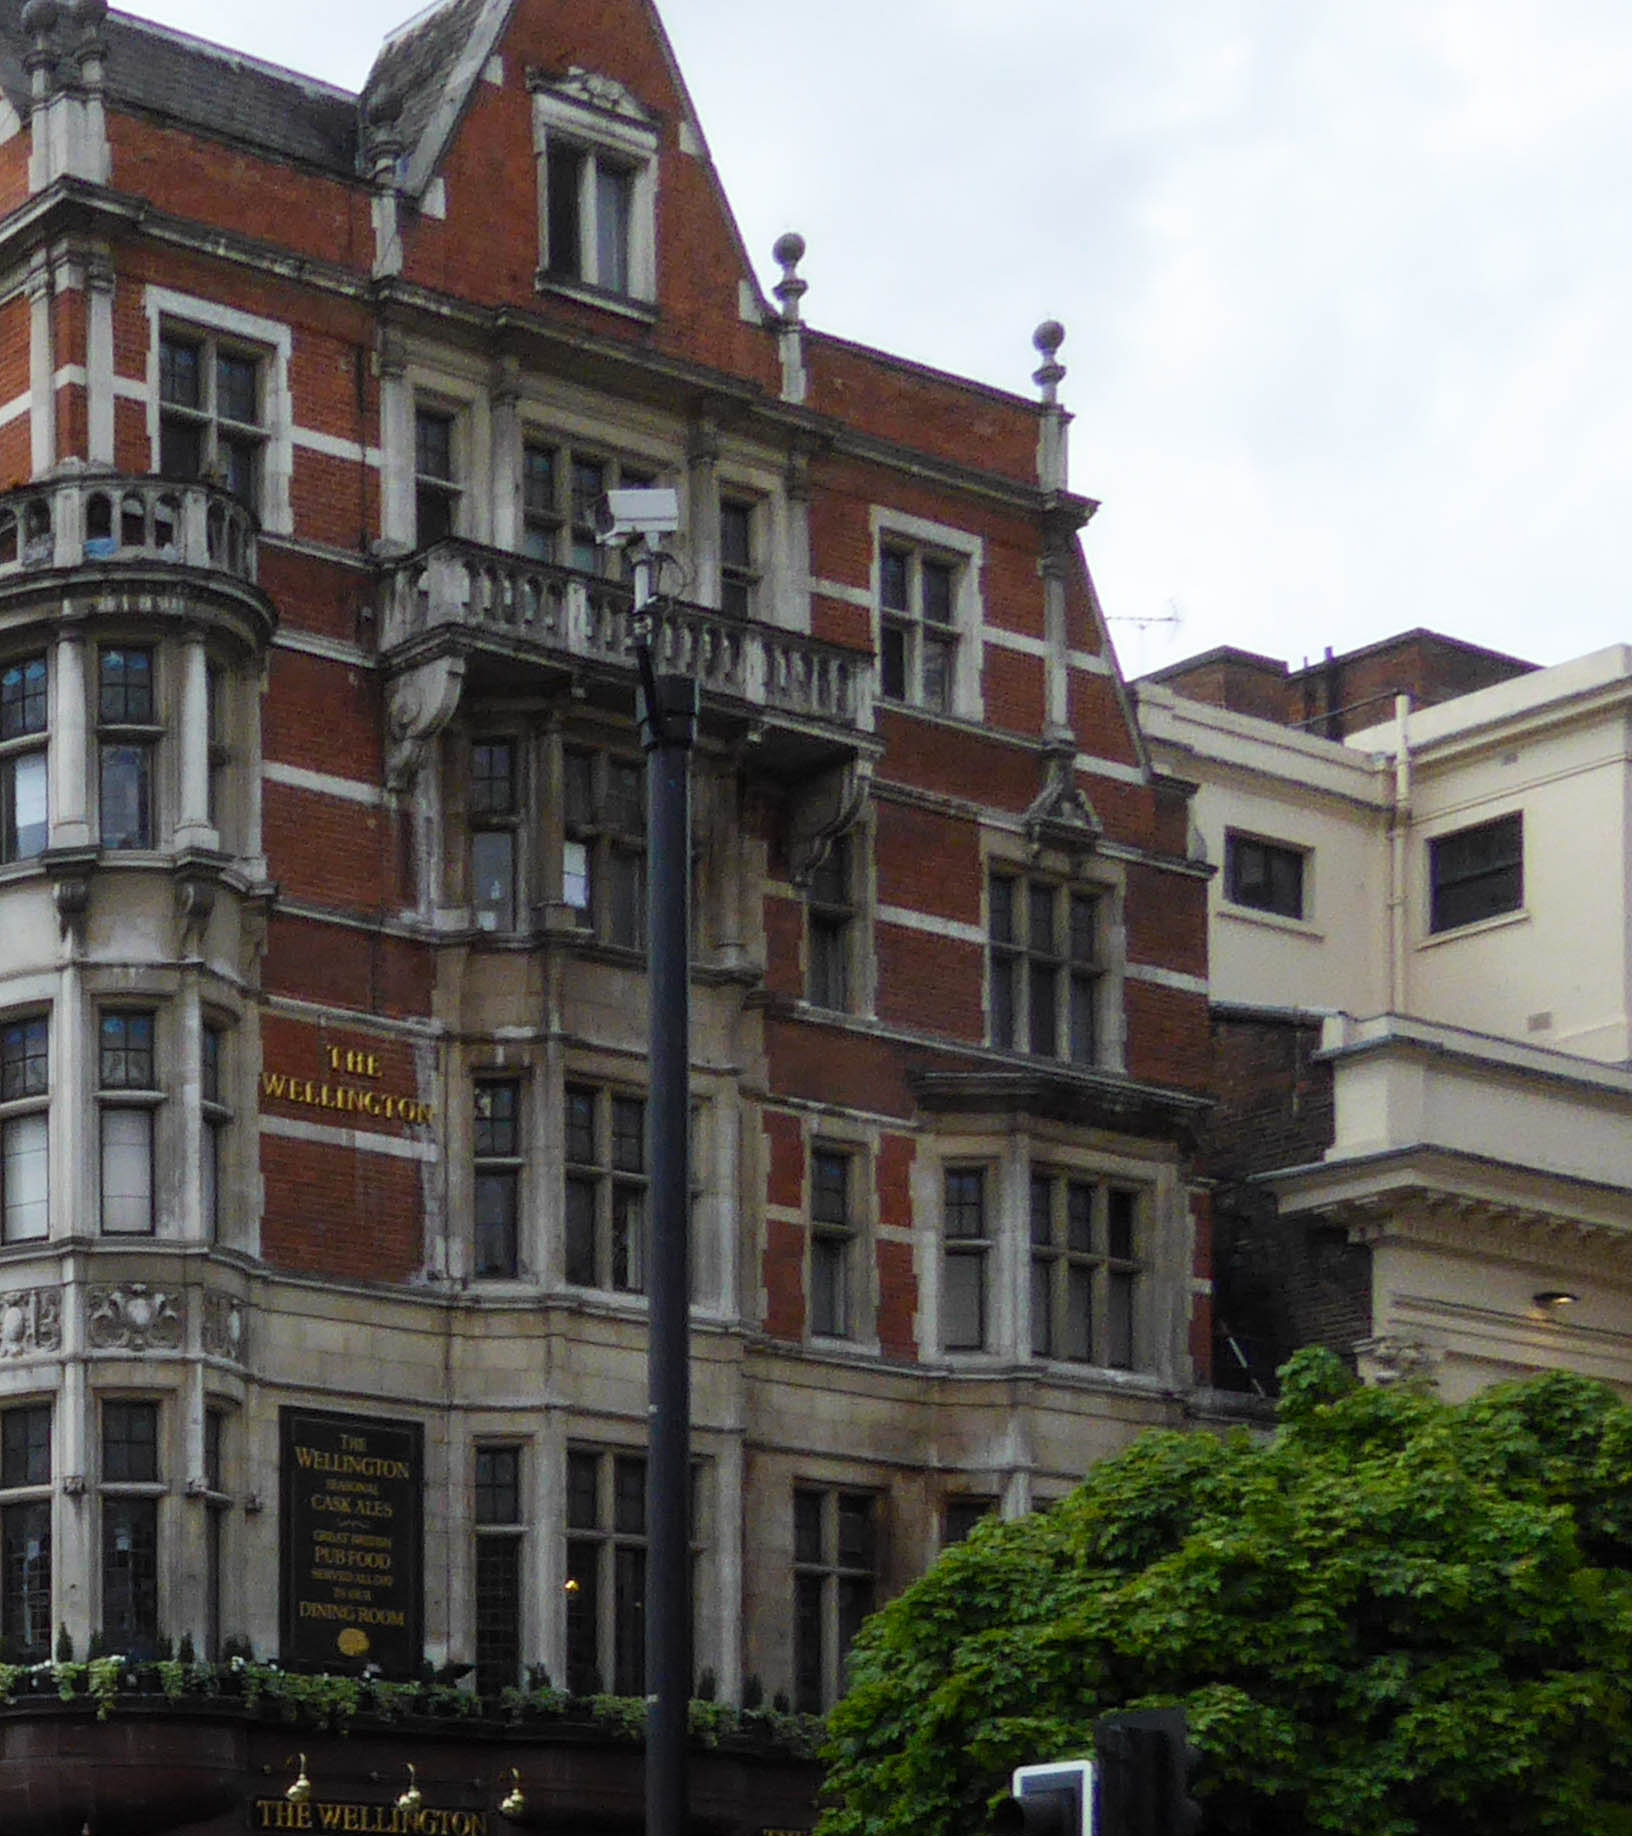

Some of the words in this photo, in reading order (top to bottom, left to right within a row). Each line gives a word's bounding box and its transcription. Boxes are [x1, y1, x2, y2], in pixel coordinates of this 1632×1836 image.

[326, 1044, 384, 1077] THE
[261, 1071, 434, 1125] WELLINGTON
[339, 1433, 367, 1452] THE
[295, 1446, 410, 1480] WELLINGTON
[311, 1494, 352, 1513] CASK
[356, 1500, 393, 1517] ALES
[315, 1546, 345, 1566] PUB
[346, 1550, 391, 1569] FOOD
[299, 1601, 357, 1621] DINING
[359, 1606, 406, 1626] ROOM
[257, 1799, 313, 1829] THE
